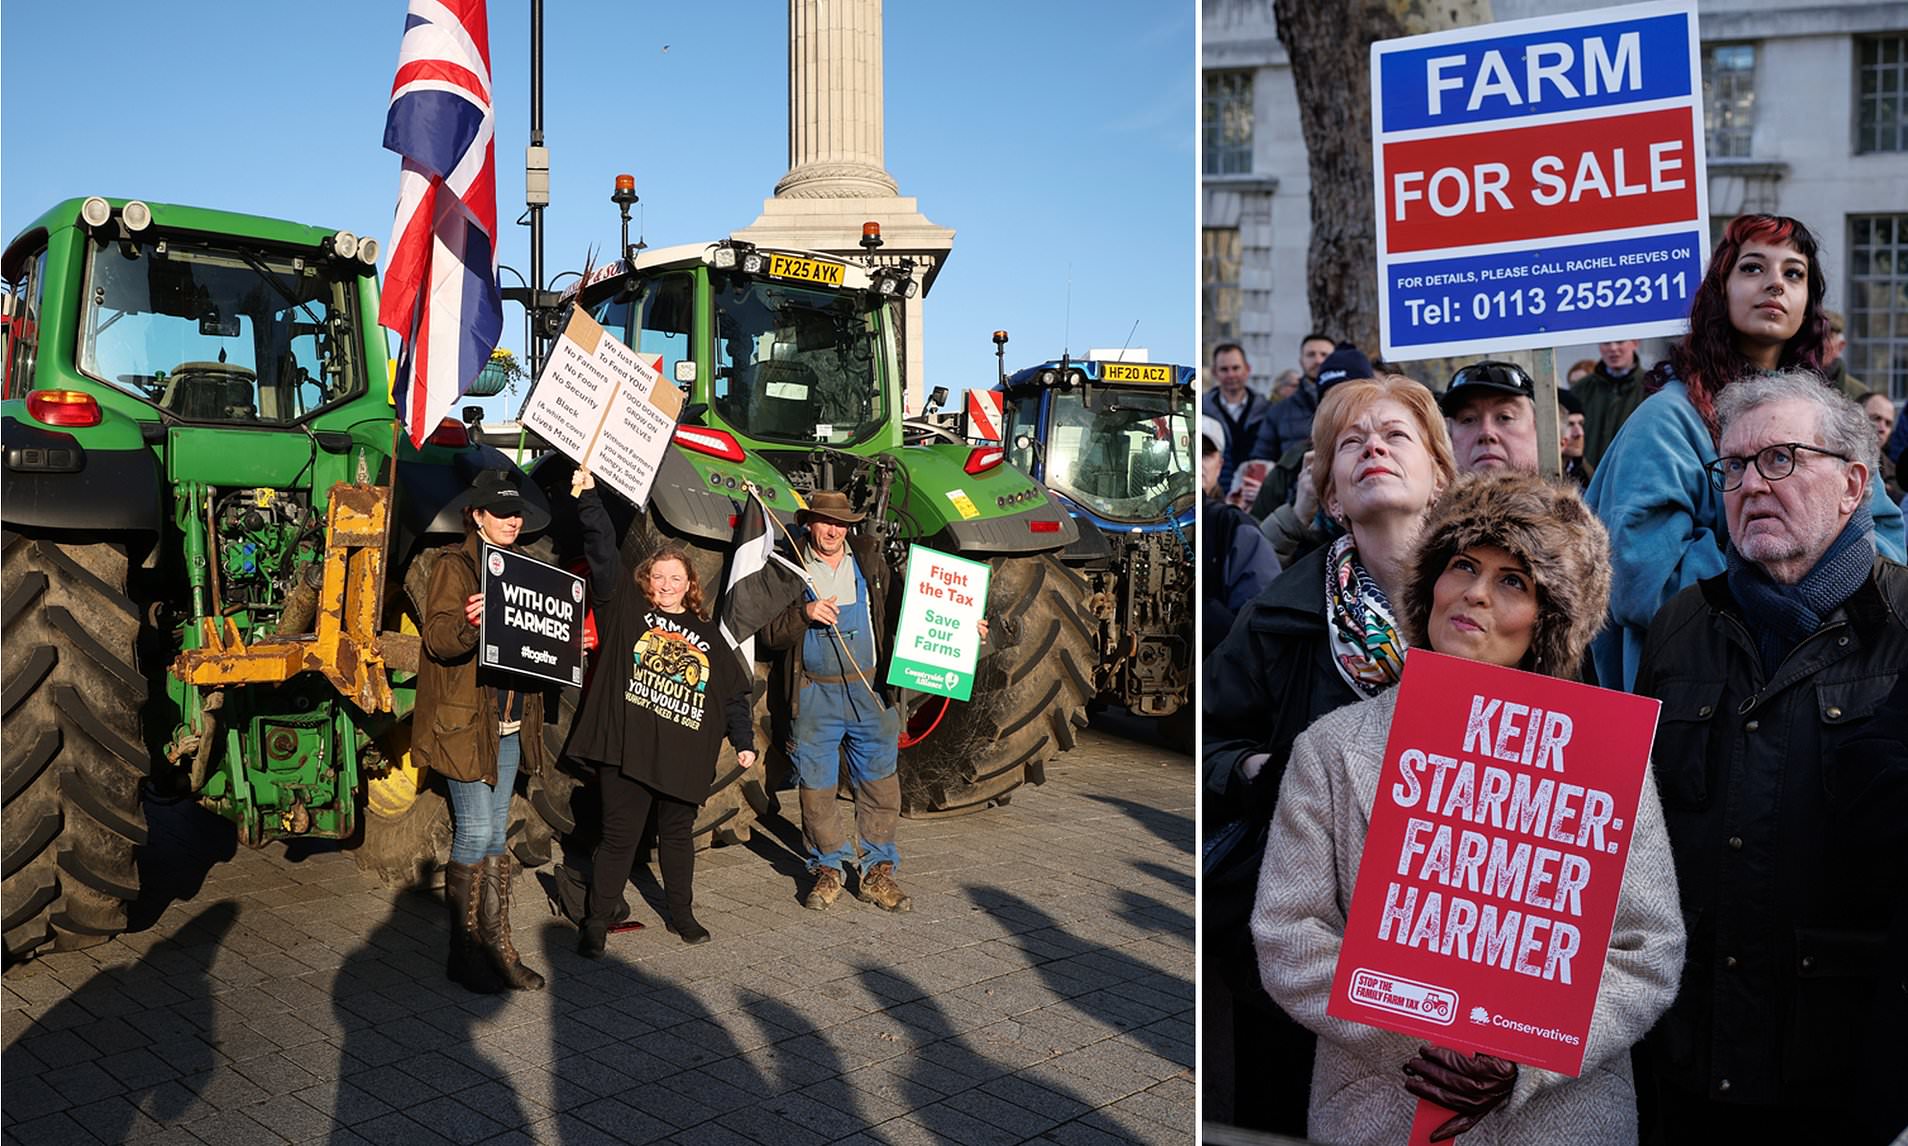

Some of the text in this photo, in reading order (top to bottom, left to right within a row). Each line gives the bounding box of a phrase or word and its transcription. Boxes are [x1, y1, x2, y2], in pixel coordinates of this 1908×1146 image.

[1426, 31, 1643, 116] FARM
[1393, 140, 1686, 222] FOR SALE
[774, 257, 839, 282] FX25 AYK
[1397, 247, 1691, 289] FOR DETAILS, PLEASE CALL RACHEL REEVES ON
[1404, 271, 1687, 326] Tel: 0113 2552311
[564, 345, 609, 383] No Farmers
[564, 363, 598, 392] No Food
[599, 353, 648, 394] To Feed YOU!
[604, 340, 653, 382] We Just Want
[1109, 366, 1165, 381] HF20 ACZ
[552, 372, 599, 410] No Security
[556, 397, 579, 418] Black
[622, 390, 670, 429] FOOD DOESN'T
[532, 413, 581, 451] Lives Matter
[537, 400, 586, 440] (& white cows)
[623, 418, 652, 442] SHELVES
[626, 406, 659, 434] GROW ON
[599, 452, 644, 487] Hungry, Sober
[603, 430, 654, 473] Without Farmers
[604, 445, 646, 477] you would be
[599, 464, 636, 494] and Naked!
[920, 581, 974, 607] the Tax
[930, 564, 969, 588] Fight
[501, 581, 573, 622] WITH OUR
[925, 609, 961, 629] Save
[504, 605, 570, 642] FARMERS
[928, 628, 954, 642] our
[521, 645, 558, 666] #together
[914, 635, 961, 658] Farms
[628, 679, 705, 722] YOU WOULD BE
[633, 663, 705, 708] WITHOUT IT
[1462, 694, 1574, 774] KEIR
[1391, 748, 1624, 855] STARMER:
[1396, 817, 1592, 917] FARMER
[1377, 881, 1582, 985] HARMER
[1355, 986, 1420, 1011] FAMILY FARM TAX
[1358, 975, 1393, 992] STOP THE
[1492, 1013, 1580, 1046] Conservatives
